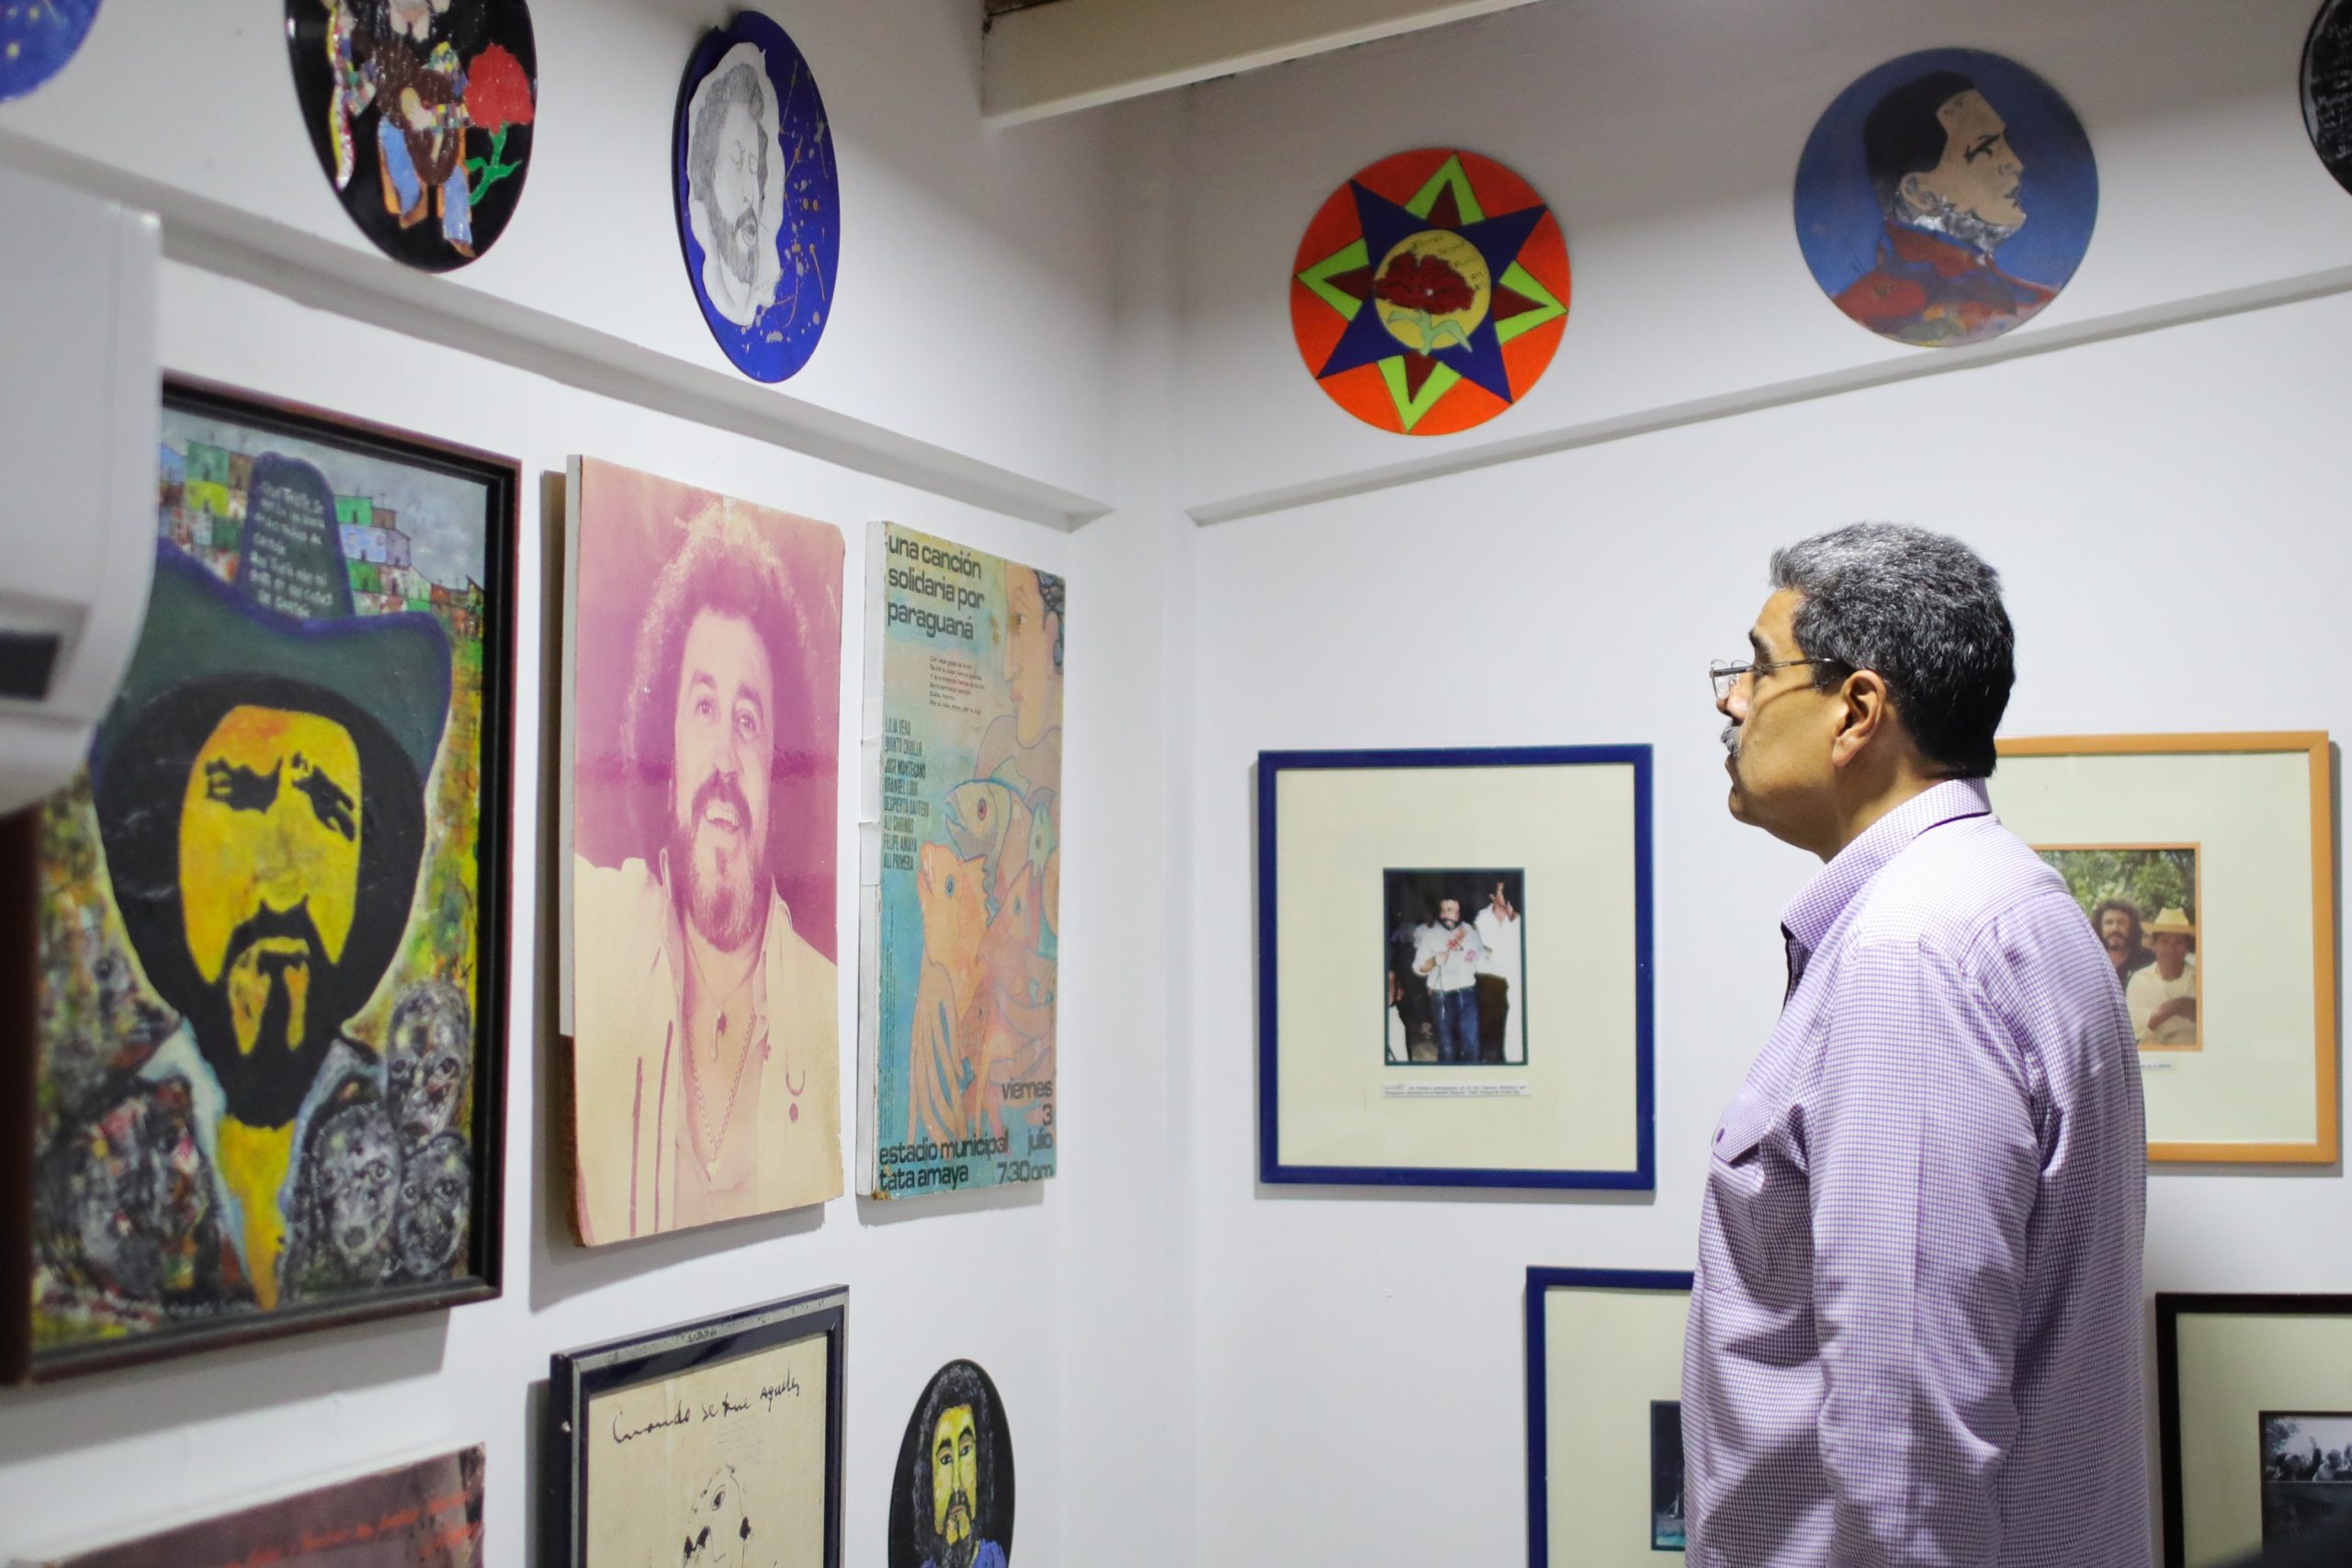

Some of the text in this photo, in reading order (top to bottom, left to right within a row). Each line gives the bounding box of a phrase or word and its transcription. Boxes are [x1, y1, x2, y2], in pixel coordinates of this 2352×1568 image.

[888, 535, 981, 578] una canción
[888, 566, 984, 610] solidaria por
[888, 602, 974, 640] paraguaná
[1001, 1077, 1053, 1100] viernes
[1042, 1102, 1053, 1126] 3
[879, 1127, 1009, 1165] estadio municipal
[879, 1164, 969, 1191] tata amaya
